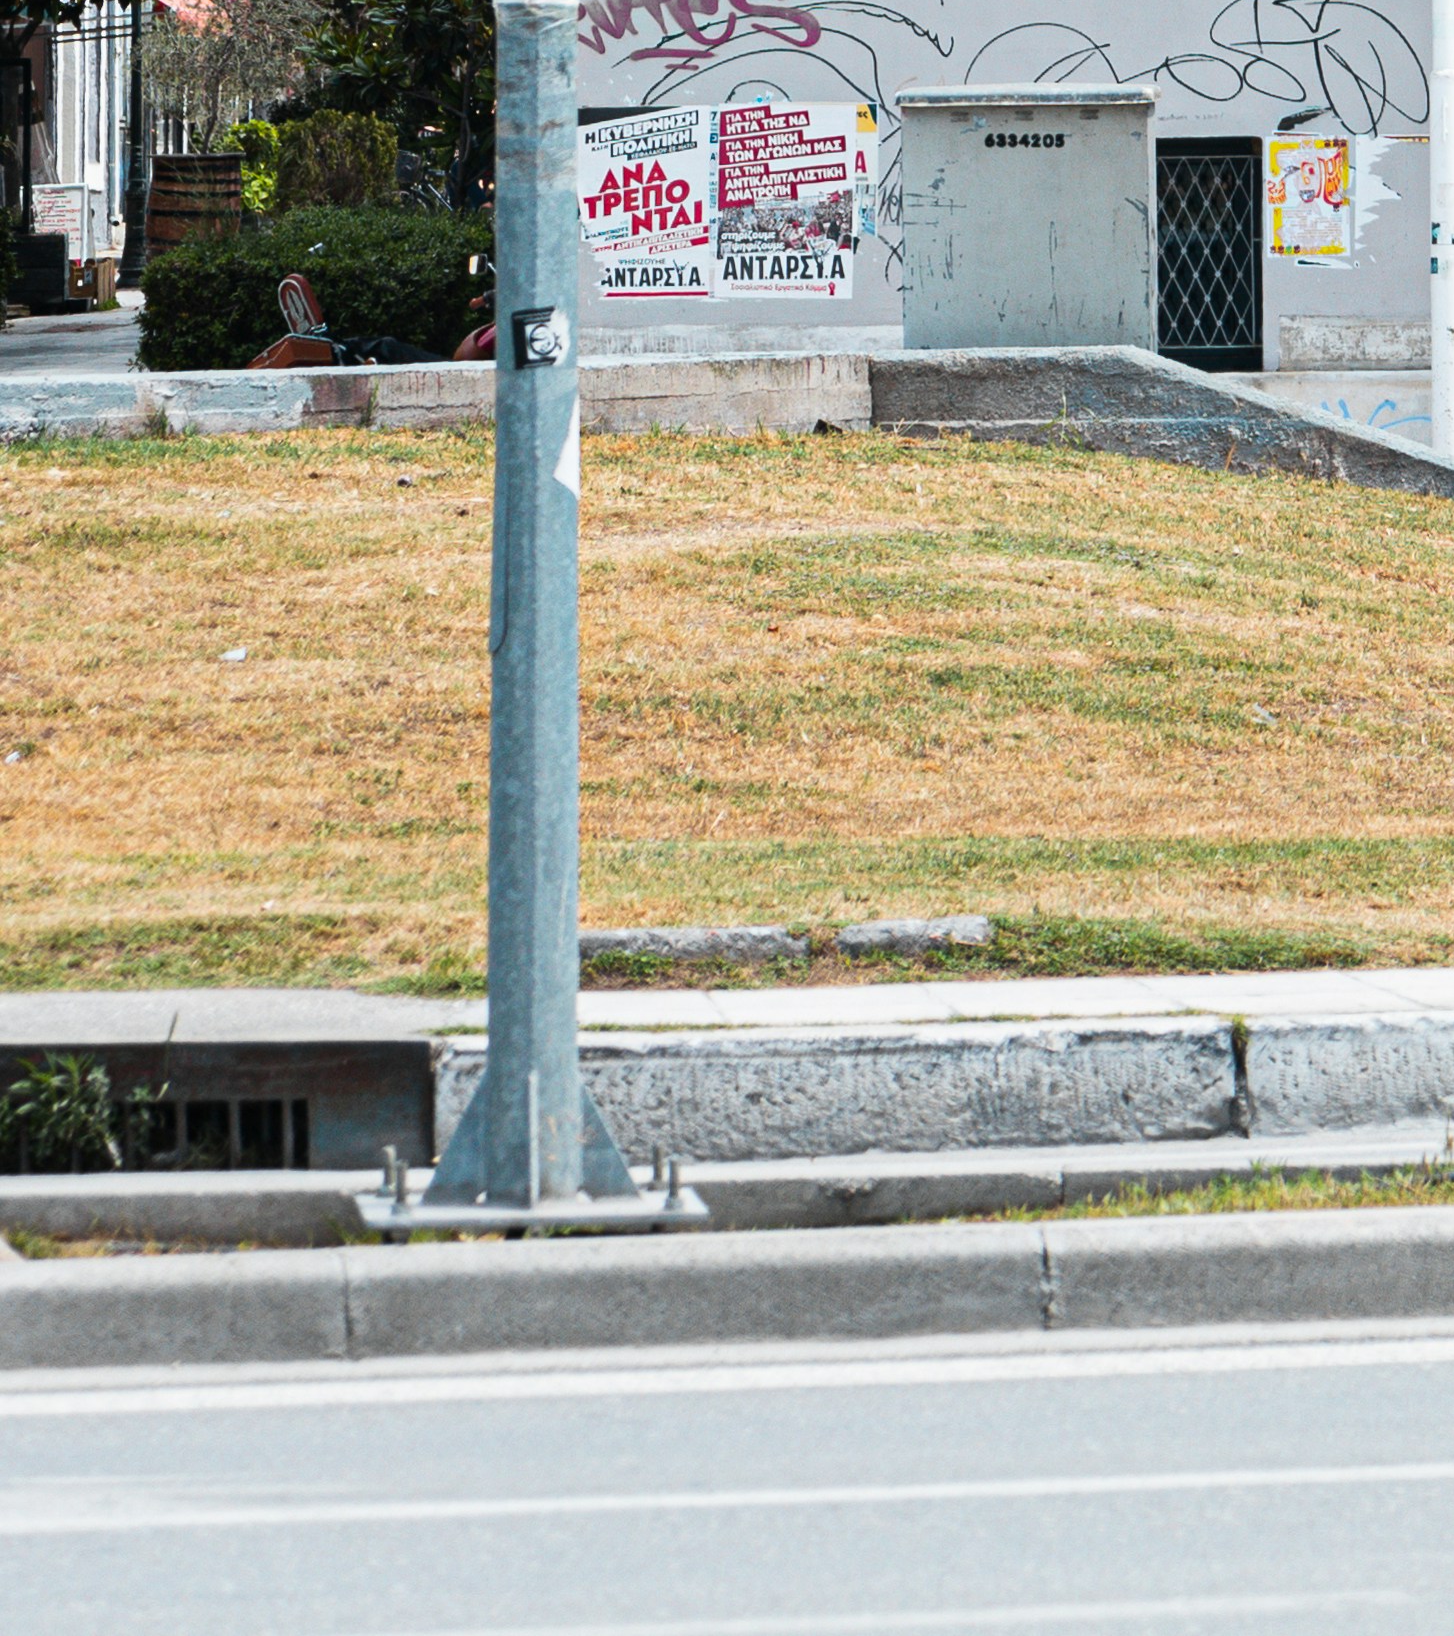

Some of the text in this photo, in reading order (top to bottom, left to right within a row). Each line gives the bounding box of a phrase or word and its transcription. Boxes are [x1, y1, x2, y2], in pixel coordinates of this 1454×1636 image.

[600, 110, 698, 143] ΚΥΒΕΡΝΗΣΗ
[725, 109, 765, 125] ΓΙΑ ΤΗΝ
[726, 113, 809, 135] ΗΤΤΑ ΤΗΣ ΝΔ
[612, 129, 691, 156] ΠΟΛΙΤΙΚΗ
[725, 132, 799, 152] ΓΙΑ ΤΗΝ ΝΙΚΗ
[726, 139, 843, 163] ΤΩΝ ΑΓΩΝΩΝ ΜΑΣ
[598, 158, 668, 194] ΑΝΑ
[724, 165, 845, 191] ΑΝΤΙΚΑΠΙΤΑΛΙΣΤΙΚΗ
[725, 165, 765, 179] ΓΙΑ ΤΗΝ
[583, 178, 691, 220] ΤΡΕΠΟ
[726, 183, 792, 202] ΑΝΑΤΡΟΠΗ
[631, 199, 703, 237] ΝΤΑΙ
